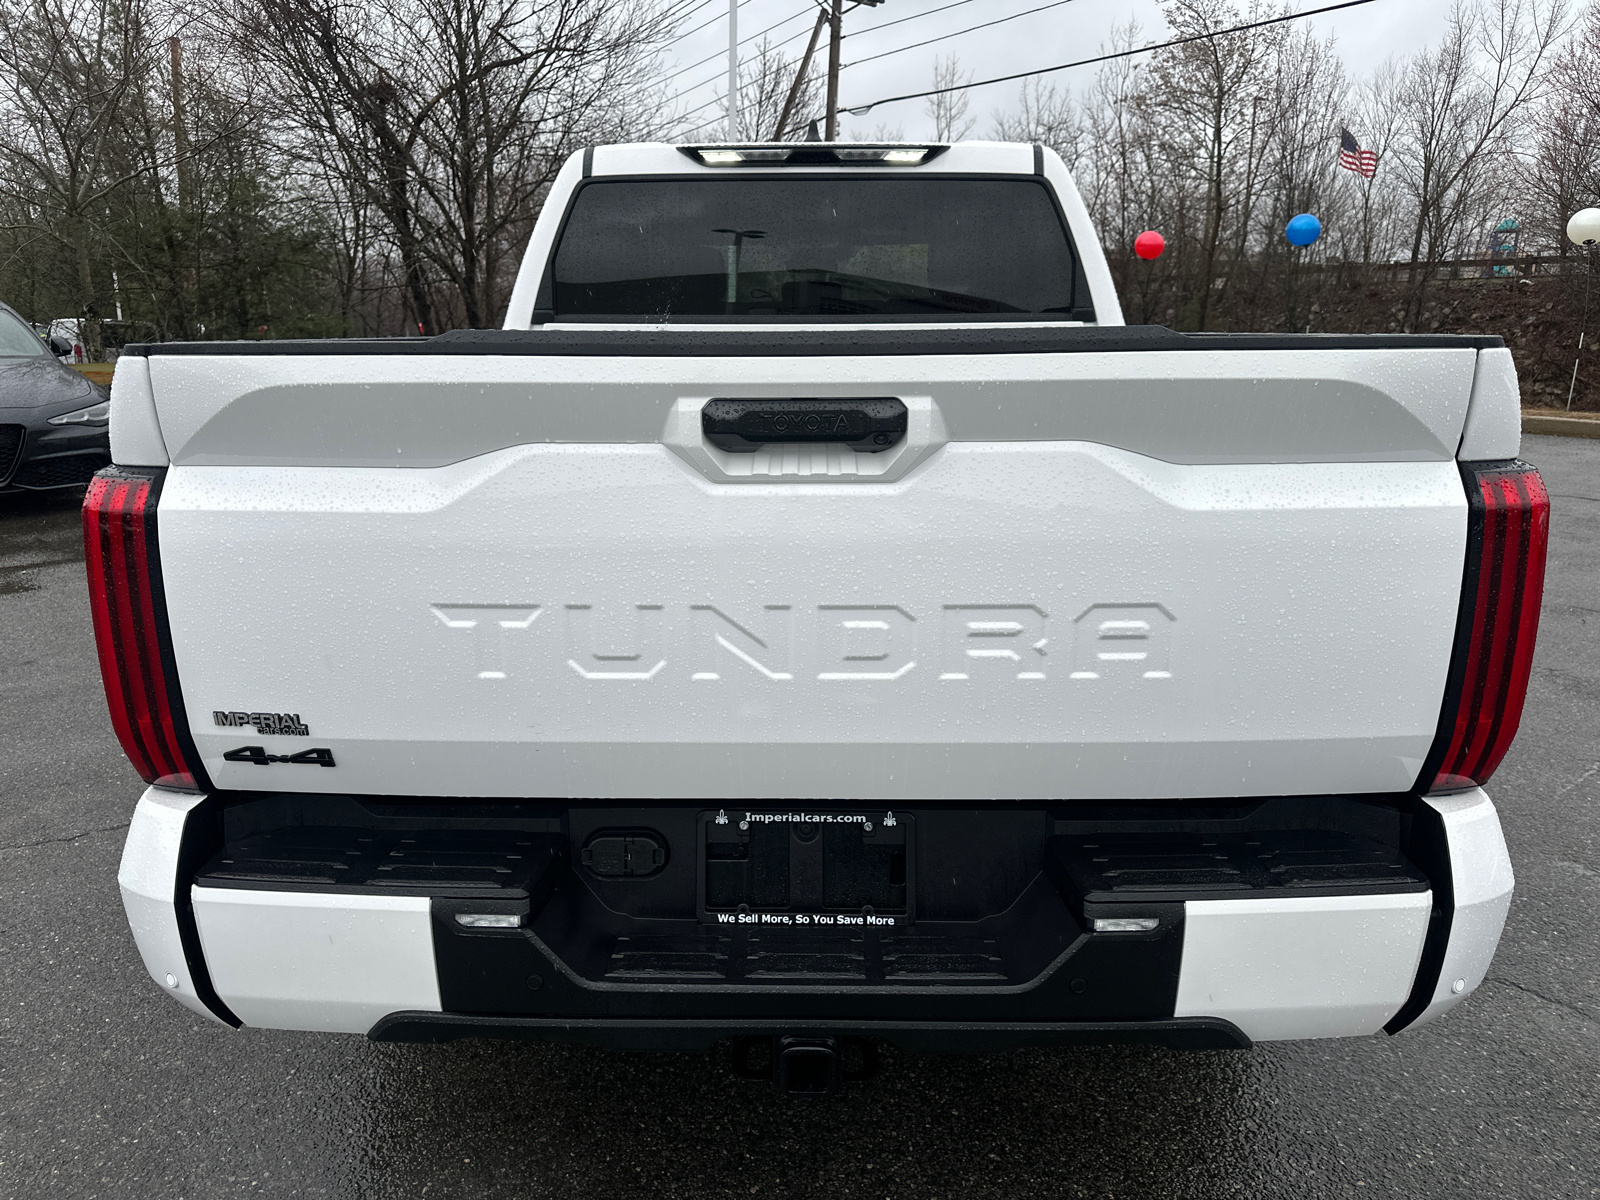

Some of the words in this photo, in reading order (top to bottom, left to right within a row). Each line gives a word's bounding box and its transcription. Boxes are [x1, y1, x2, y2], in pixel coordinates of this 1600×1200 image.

[759, 412, 850, 432] TOYOTA
[430, 602, 1177, 681] TUNDRA
[213, 711, 308, 729] IMPERIAL
[257, 726, 309, 736] cars.com
[745, 812, 867, 824] Imperialcars.com
[717, 914, 735, 924] We
[738, 914, 758, 924] Sell
[762, 914, 793, 925] More,
[795, 915, 810, 924] So
[813, 915, 834, 925] You
[836, 915, 864, 925] Save
[866, 916, 895, 926] More
